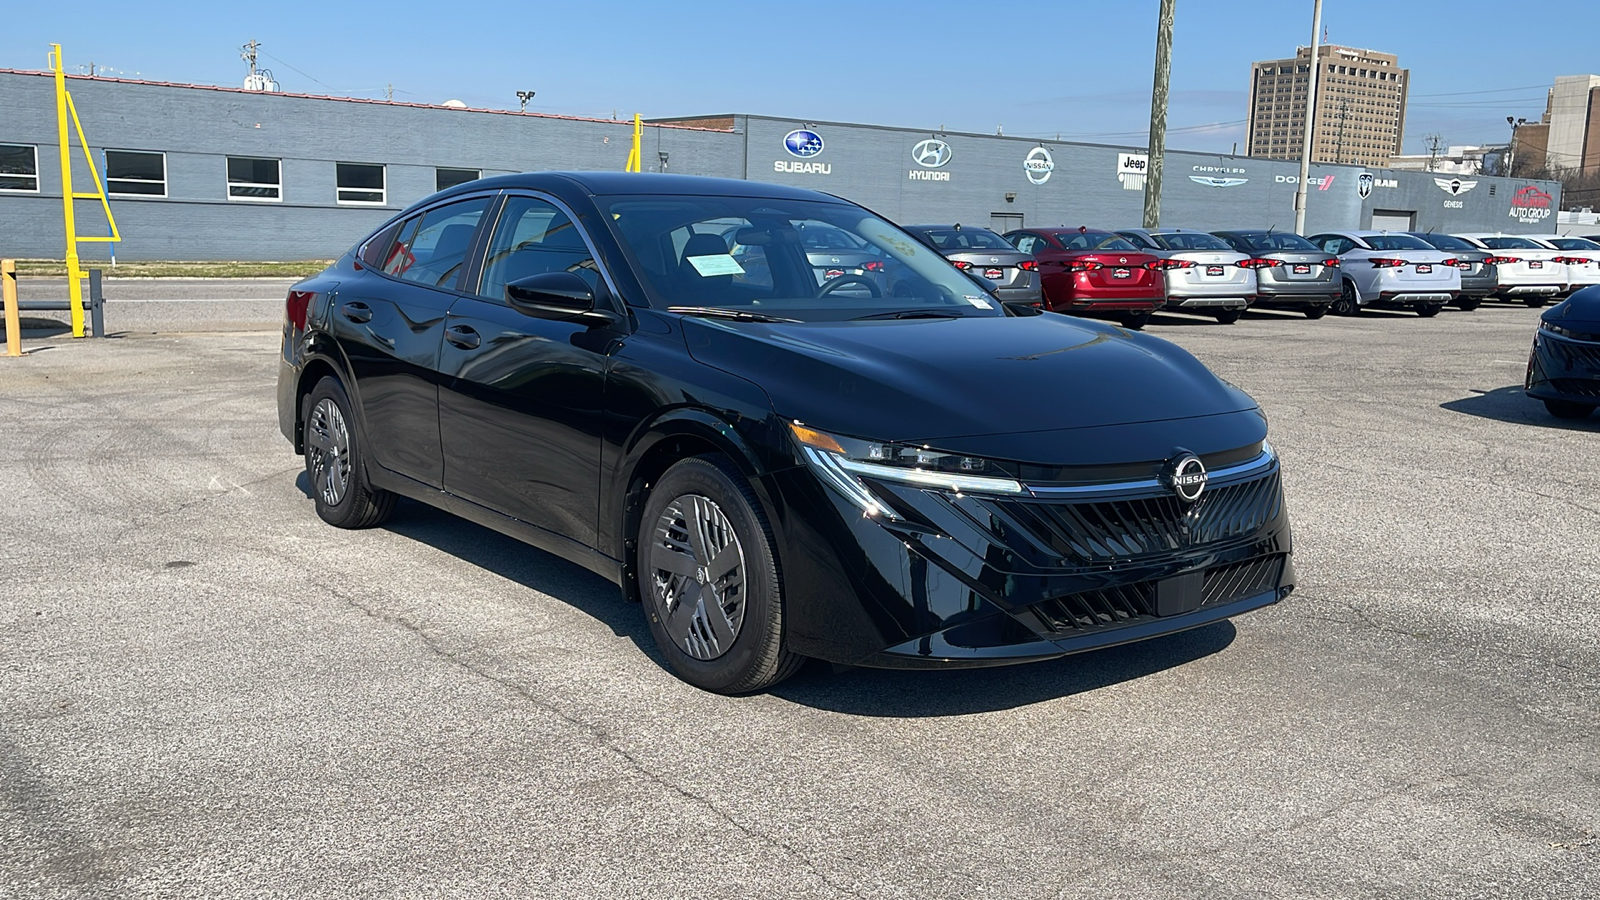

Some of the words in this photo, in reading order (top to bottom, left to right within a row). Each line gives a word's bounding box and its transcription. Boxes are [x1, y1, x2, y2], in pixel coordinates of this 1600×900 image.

[774, 160, 831, 174] SUBARU
[1026, 161, 1051, 170] NISSAN
[1123, 156, 1146, 171] Jeep
[909, 170, 950, 181] HYUNDAI
[1192, 165, 1246, 175] CHRYSLER
[1275, 175, 1326, 186] DOGE
[1374, 178, 1398, 188] RAM
[1443, 200, 1463, 209] GENESIS
[1508, 206, 1527, 218] AUTO
[1528, 207, 1551, 219] GROUP
[1173, 473, 1208, 485] NISSAN
